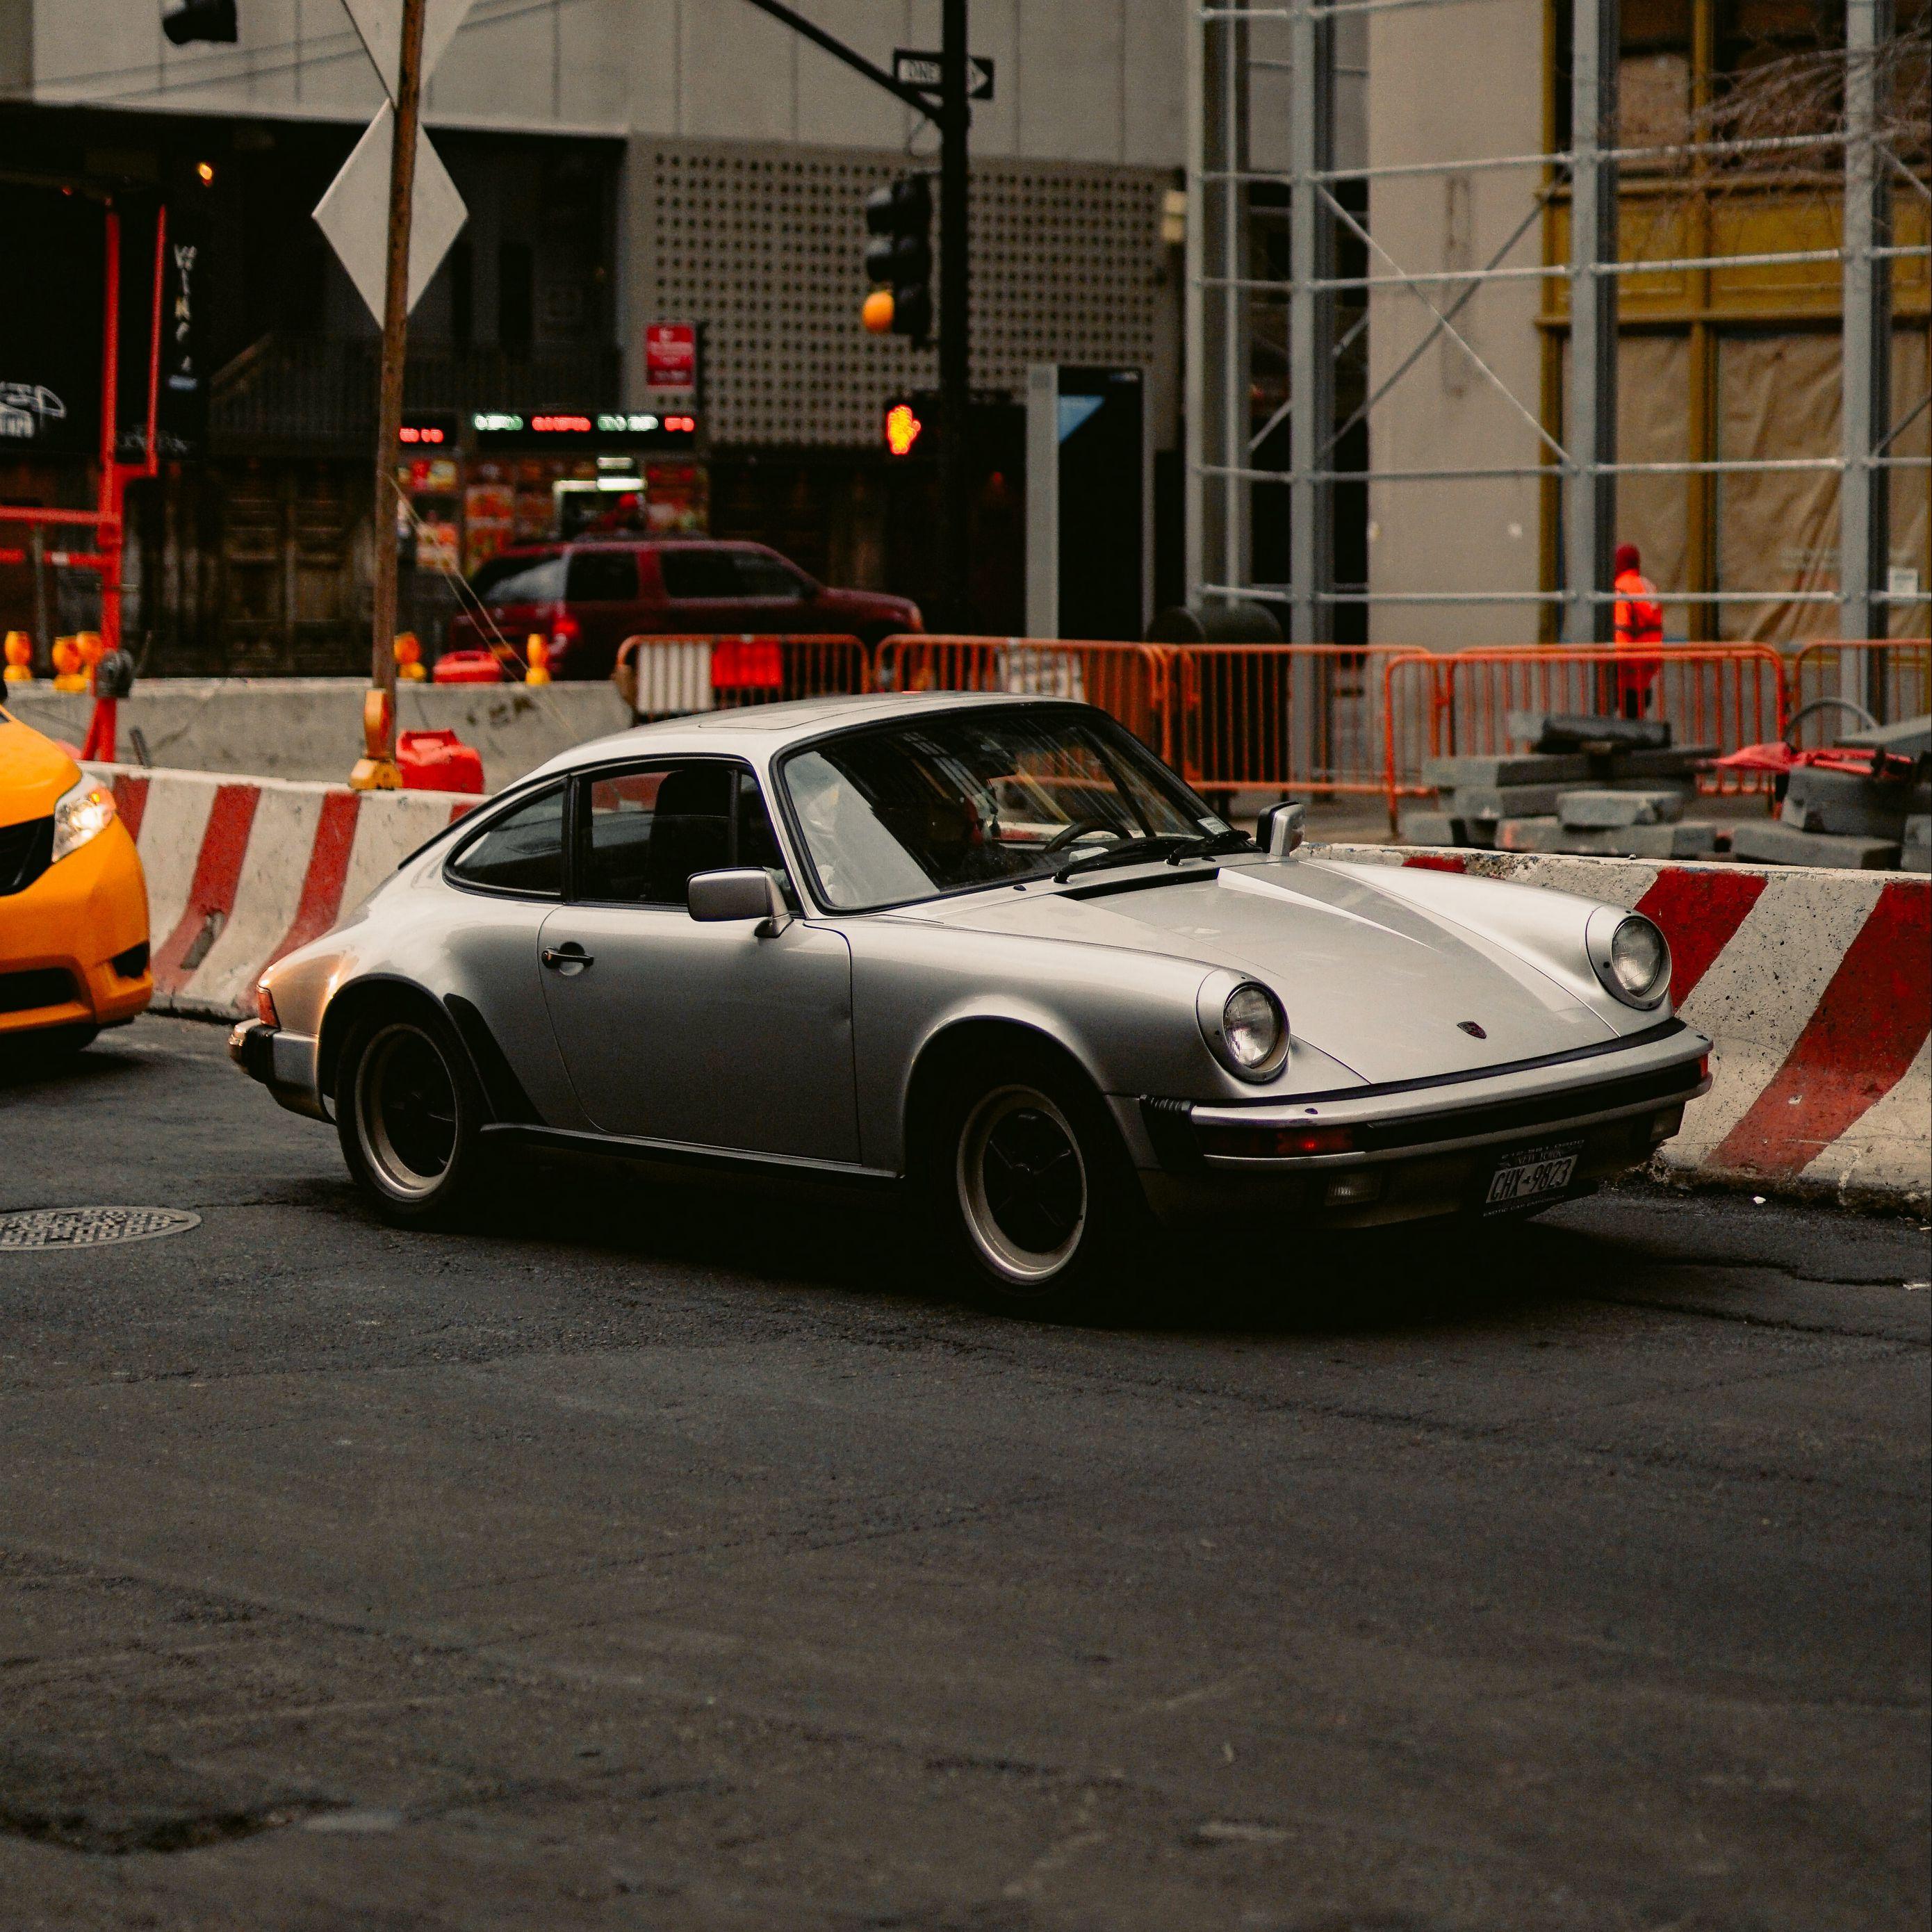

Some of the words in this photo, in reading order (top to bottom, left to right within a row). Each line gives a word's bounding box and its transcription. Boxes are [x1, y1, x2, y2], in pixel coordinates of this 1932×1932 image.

[1517, 1152, 1535, 1164] NEW
[1540, 1148, 1562, 1161] YORK
[1483, 1207, 1509, 1217] EXOTIC
